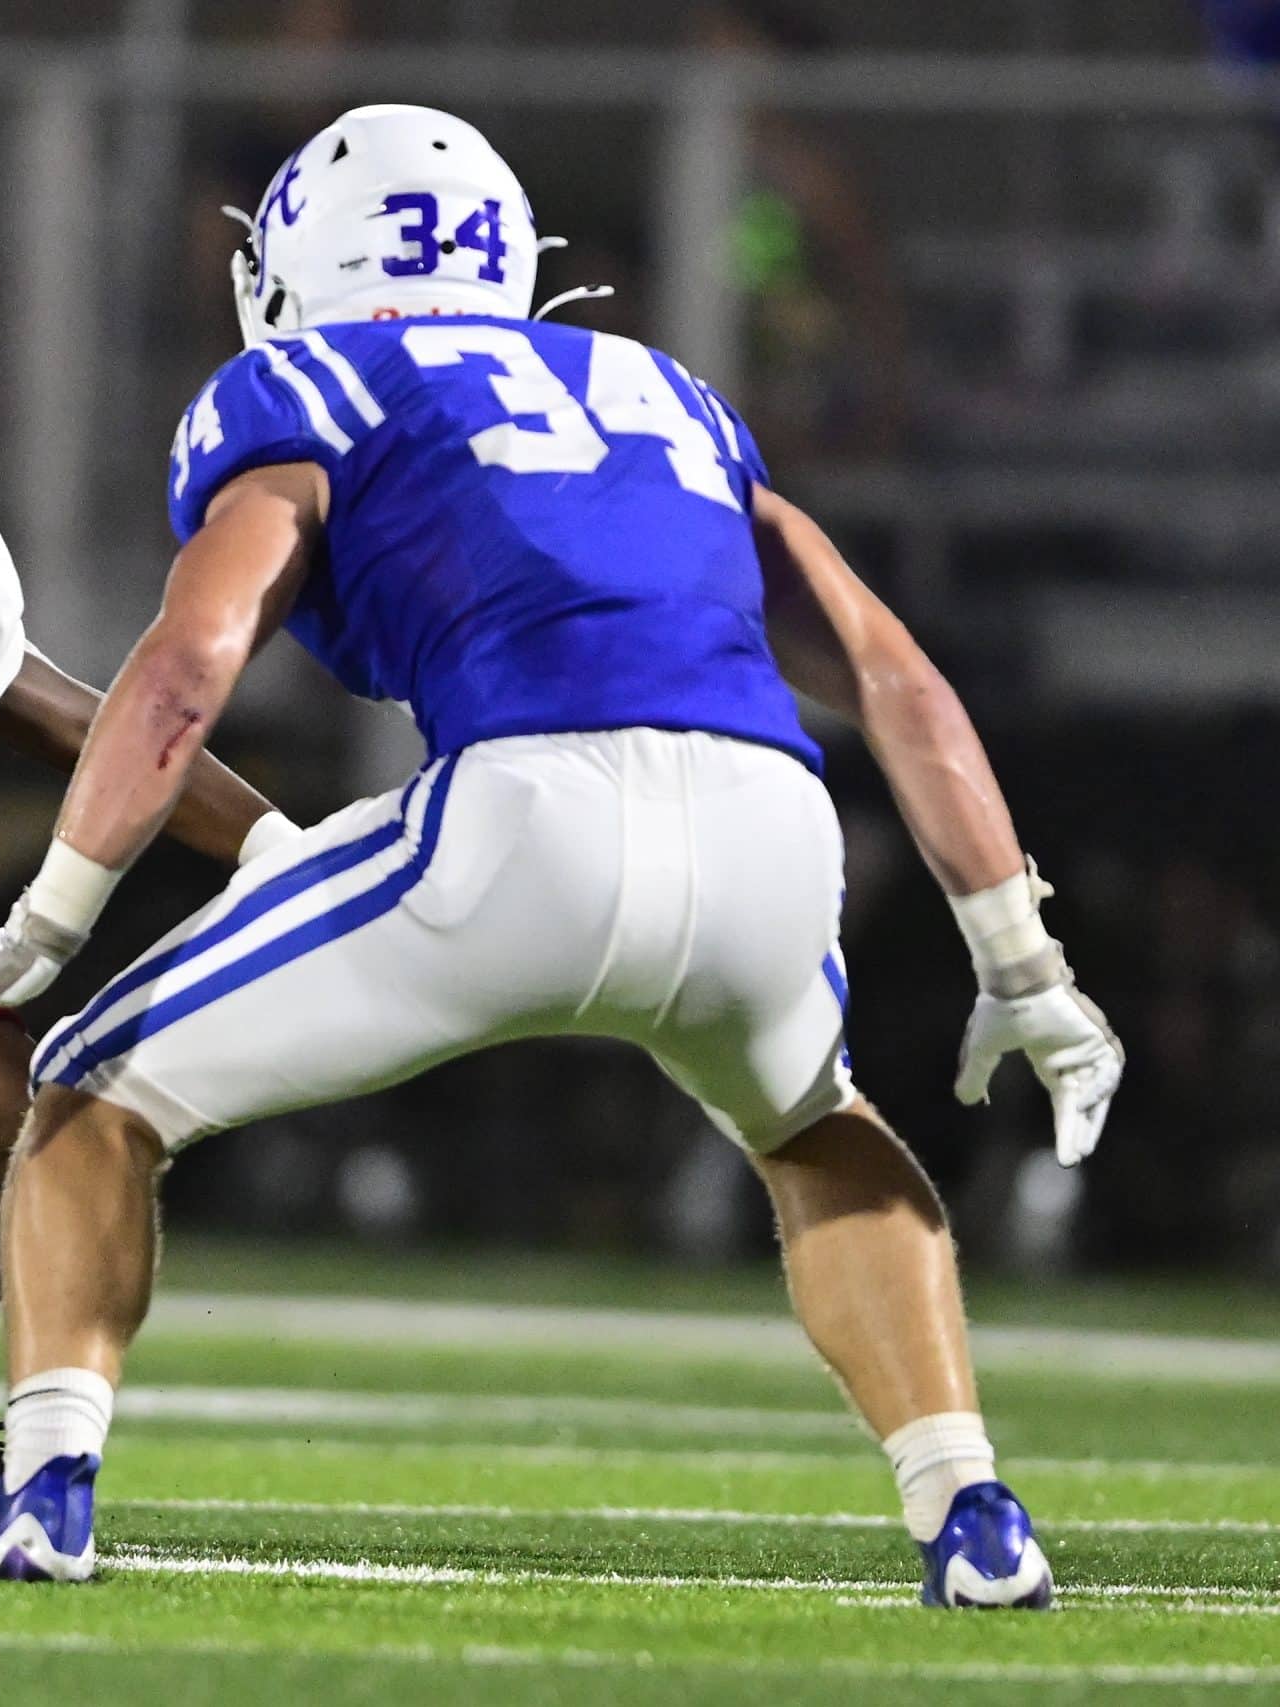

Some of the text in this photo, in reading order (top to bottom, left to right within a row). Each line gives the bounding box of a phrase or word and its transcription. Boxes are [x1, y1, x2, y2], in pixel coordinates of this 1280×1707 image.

[381, 192, 506, 284] 34
[170, 380, 224, 500] 34
[401, 325, 743, 513] 34
